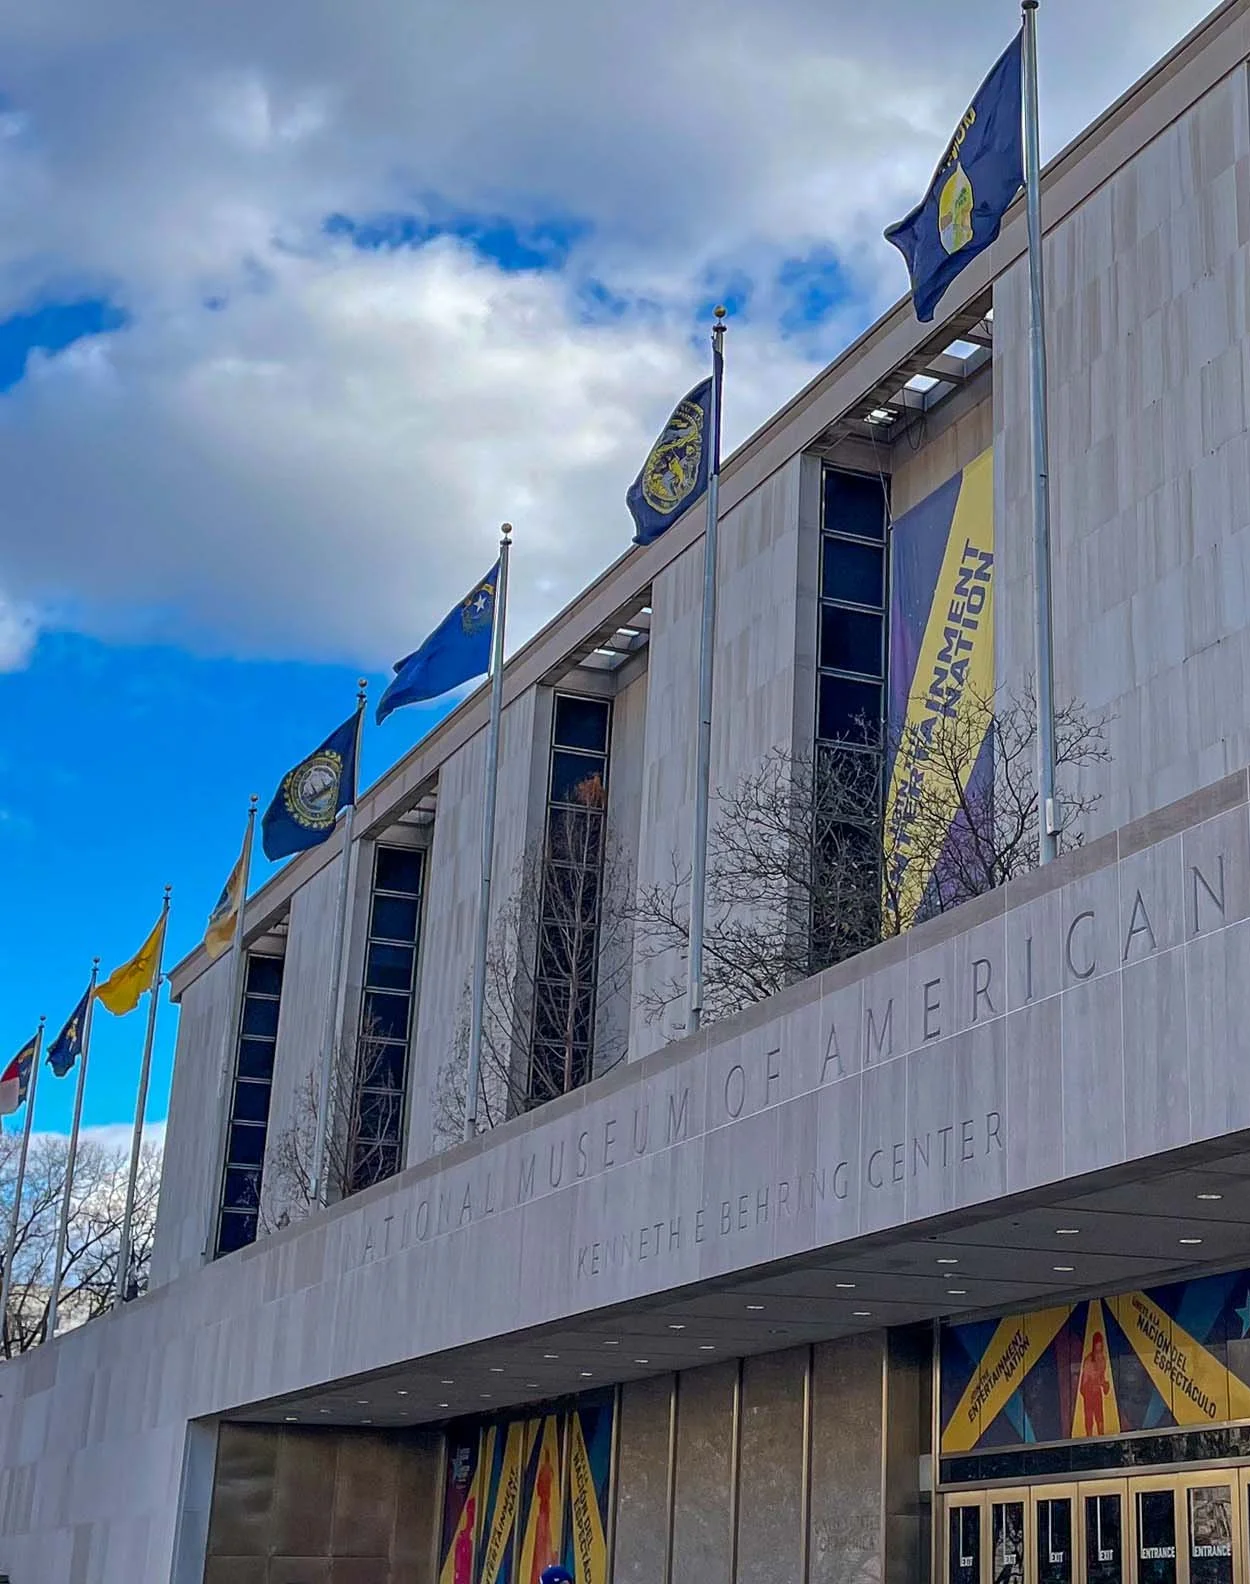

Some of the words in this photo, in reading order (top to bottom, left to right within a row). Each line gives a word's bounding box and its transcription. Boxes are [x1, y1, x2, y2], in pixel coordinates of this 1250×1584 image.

[945, 551, 994, 719] NATION
[517, 1086, 690, 1205] MUSEUM
[724, 1047, 781, 1119] OF
[819, 854, 1227, 1083] AMERICAN
[577, 1215, 682, 1281] KENNETH
[694, 1210, 705, 1244] E
[719, 1161, 849, 1237] BEHRING
[866, 1110, 1003, 1190] CENTER
[967, 1329, 1024, 1423] ENTERTAINMENT
[1003, 1335, 1031, 1382] NATION
[1136, 1313, 1172, 1354] NACIÓN
[1171, 1345, 1187, 1372] DEL
[1153, 1350, 1217, 1419] ESPECTÁCULO
[1140, 1547, 1176, 1559] ENTRANCE
[1192, 1545, 1232, 1557] ENTRANCE
